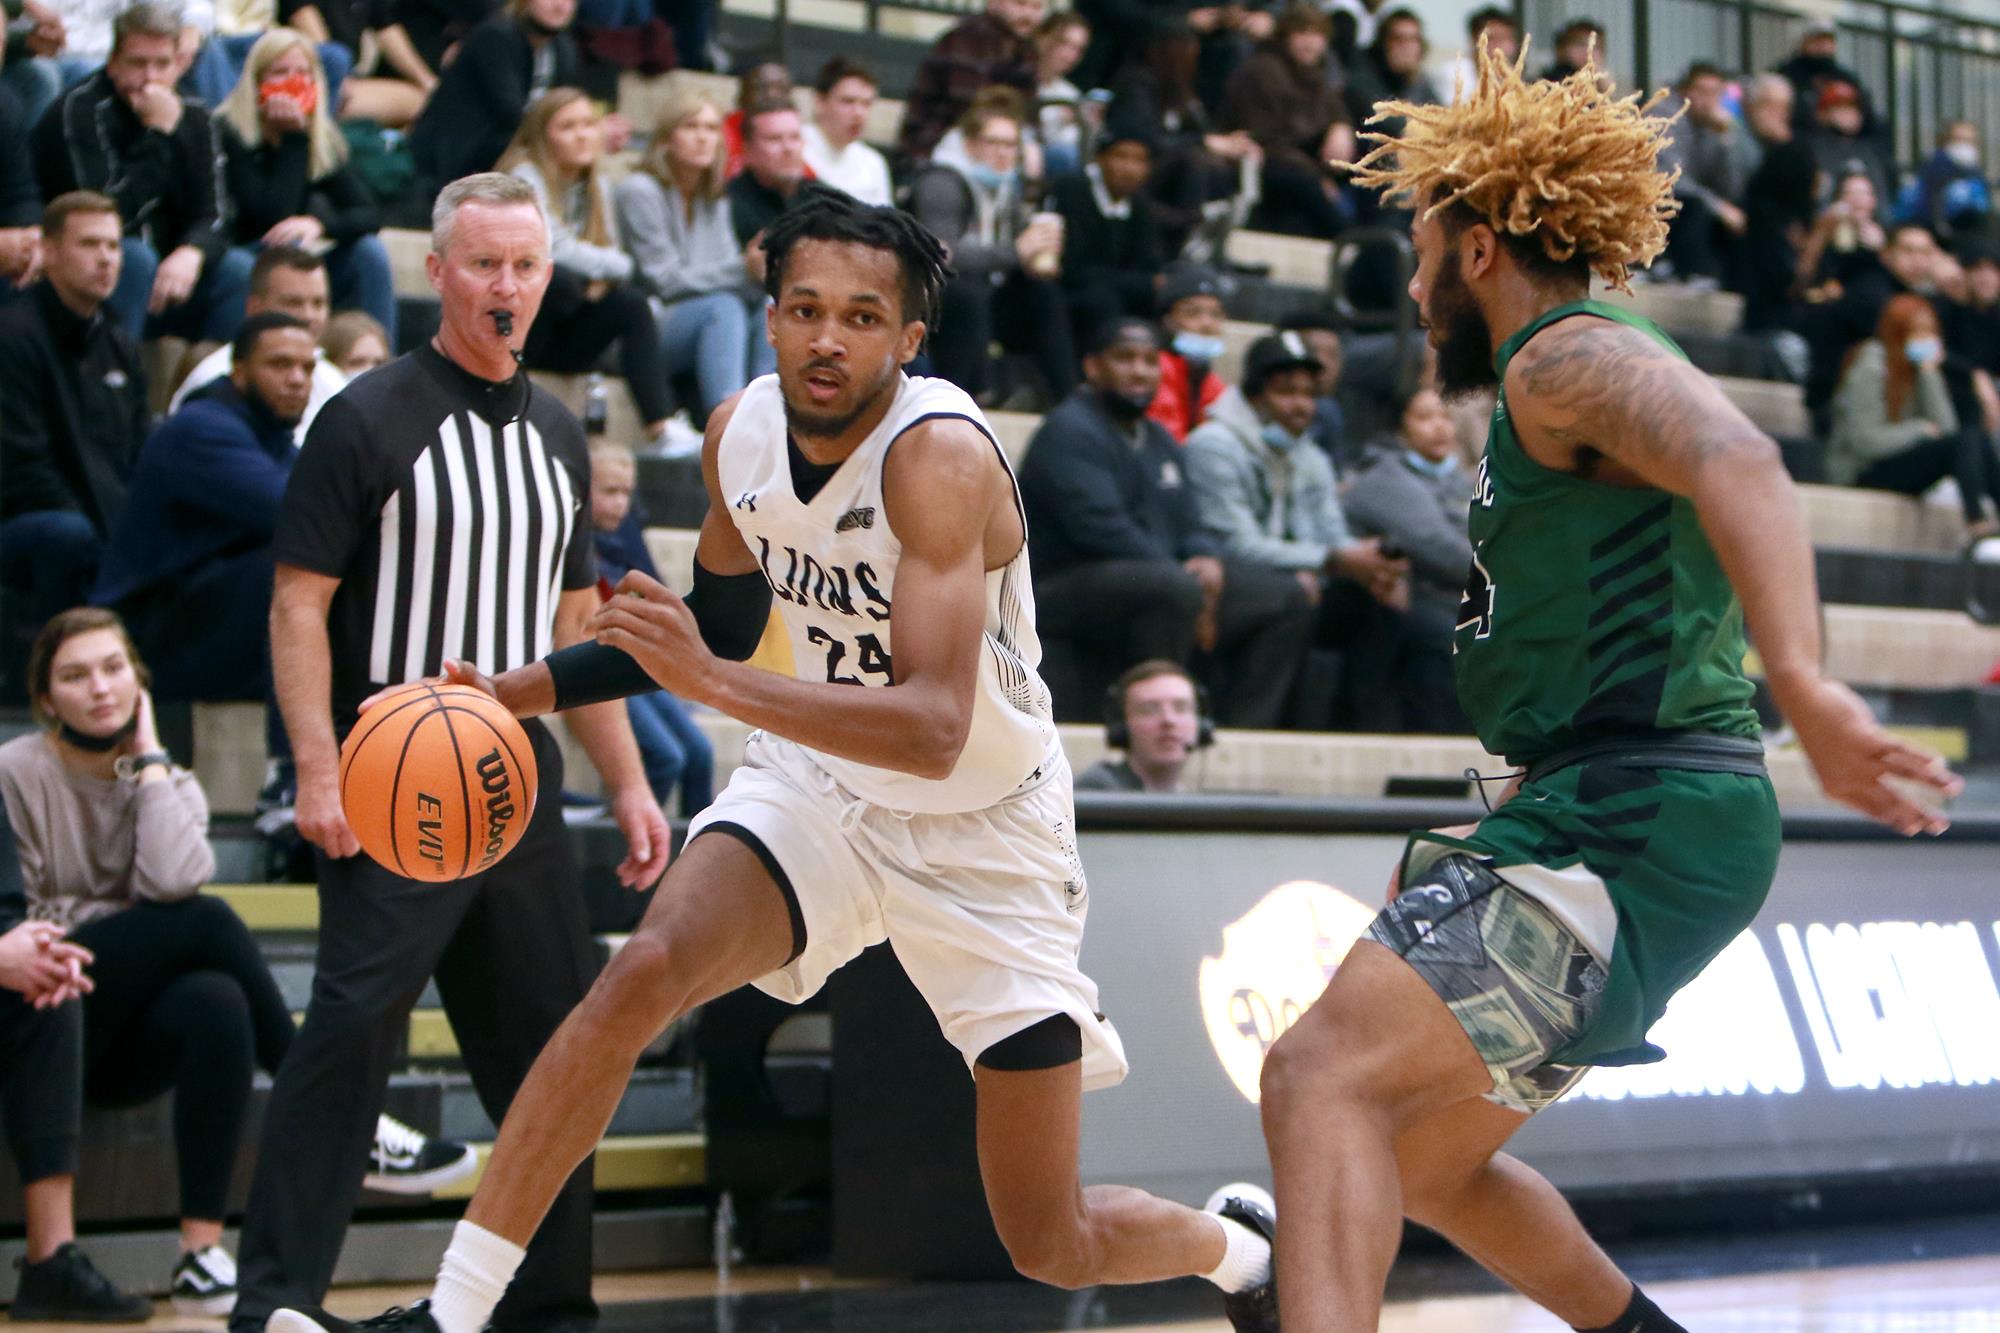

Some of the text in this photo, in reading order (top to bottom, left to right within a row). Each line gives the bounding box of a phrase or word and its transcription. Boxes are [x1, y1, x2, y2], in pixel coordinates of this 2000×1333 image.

[757, 535, 891, 622] LIONS
[807, 624, 895, 687] 24
[417, 792, 444, 862] EVO
[476, 747, 515, 870] Wilson
